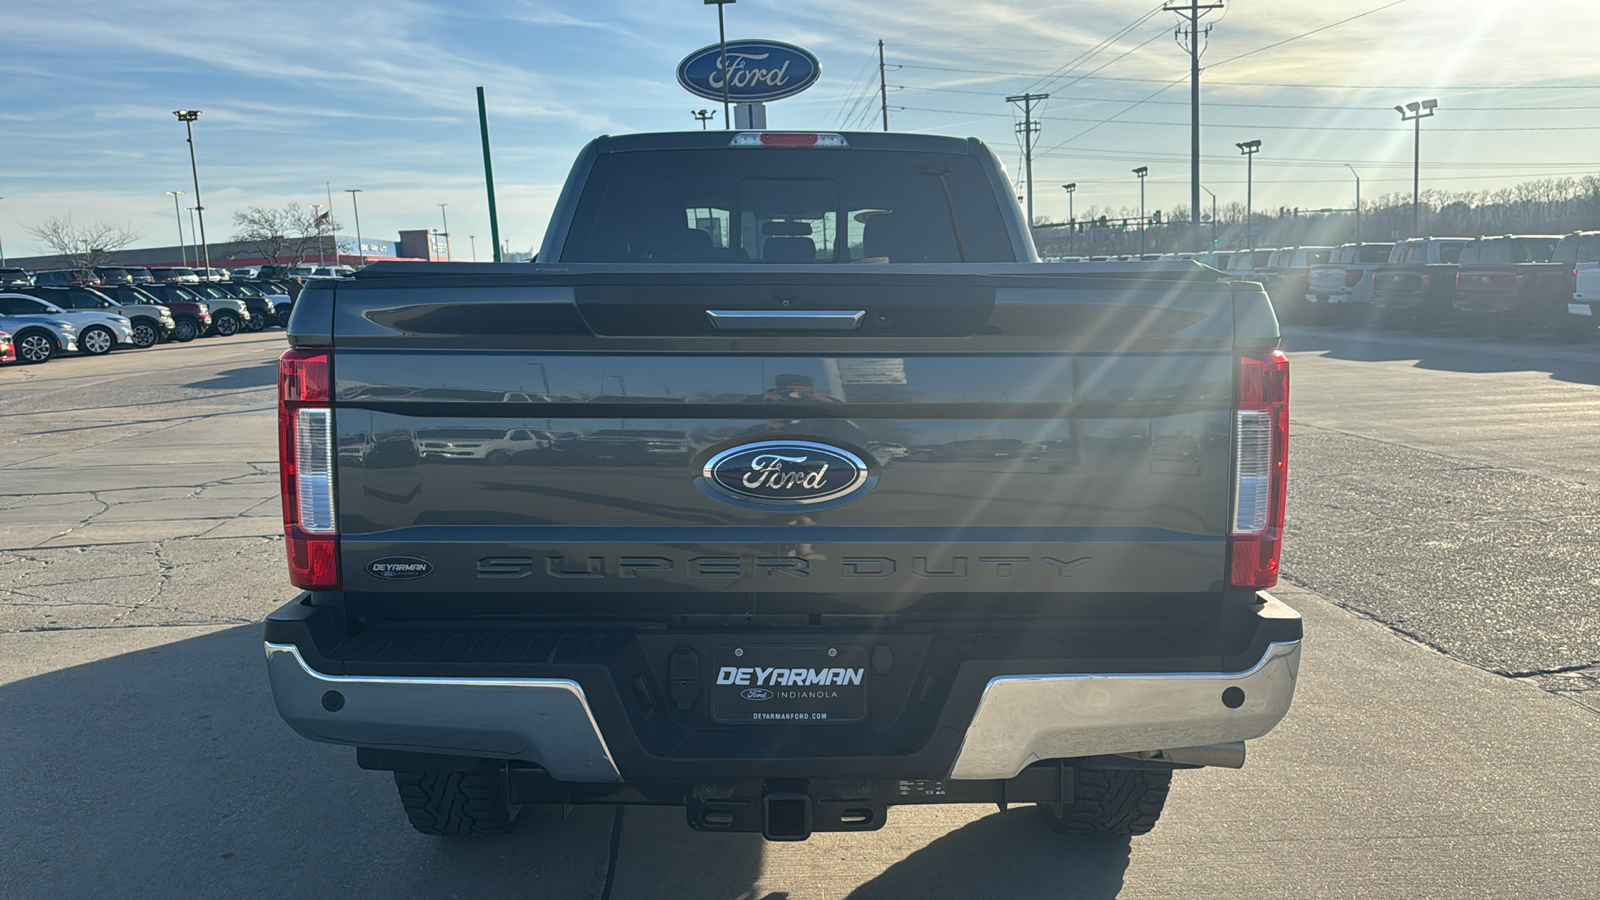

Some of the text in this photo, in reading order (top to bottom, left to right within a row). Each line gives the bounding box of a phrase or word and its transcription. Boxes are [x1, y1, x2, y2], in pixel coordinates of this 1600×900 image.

[708, 53, 791, 88] Ford
[742, 454, 829, 489] Ford
[373, 563, 427, 571] DEYARMAN
[476, 556, 1093, 579] SUPER DUTY
[716, 666, 865, 686] DEYARMAN
[746, 690, 838, 699] Ford INDIANOLA
